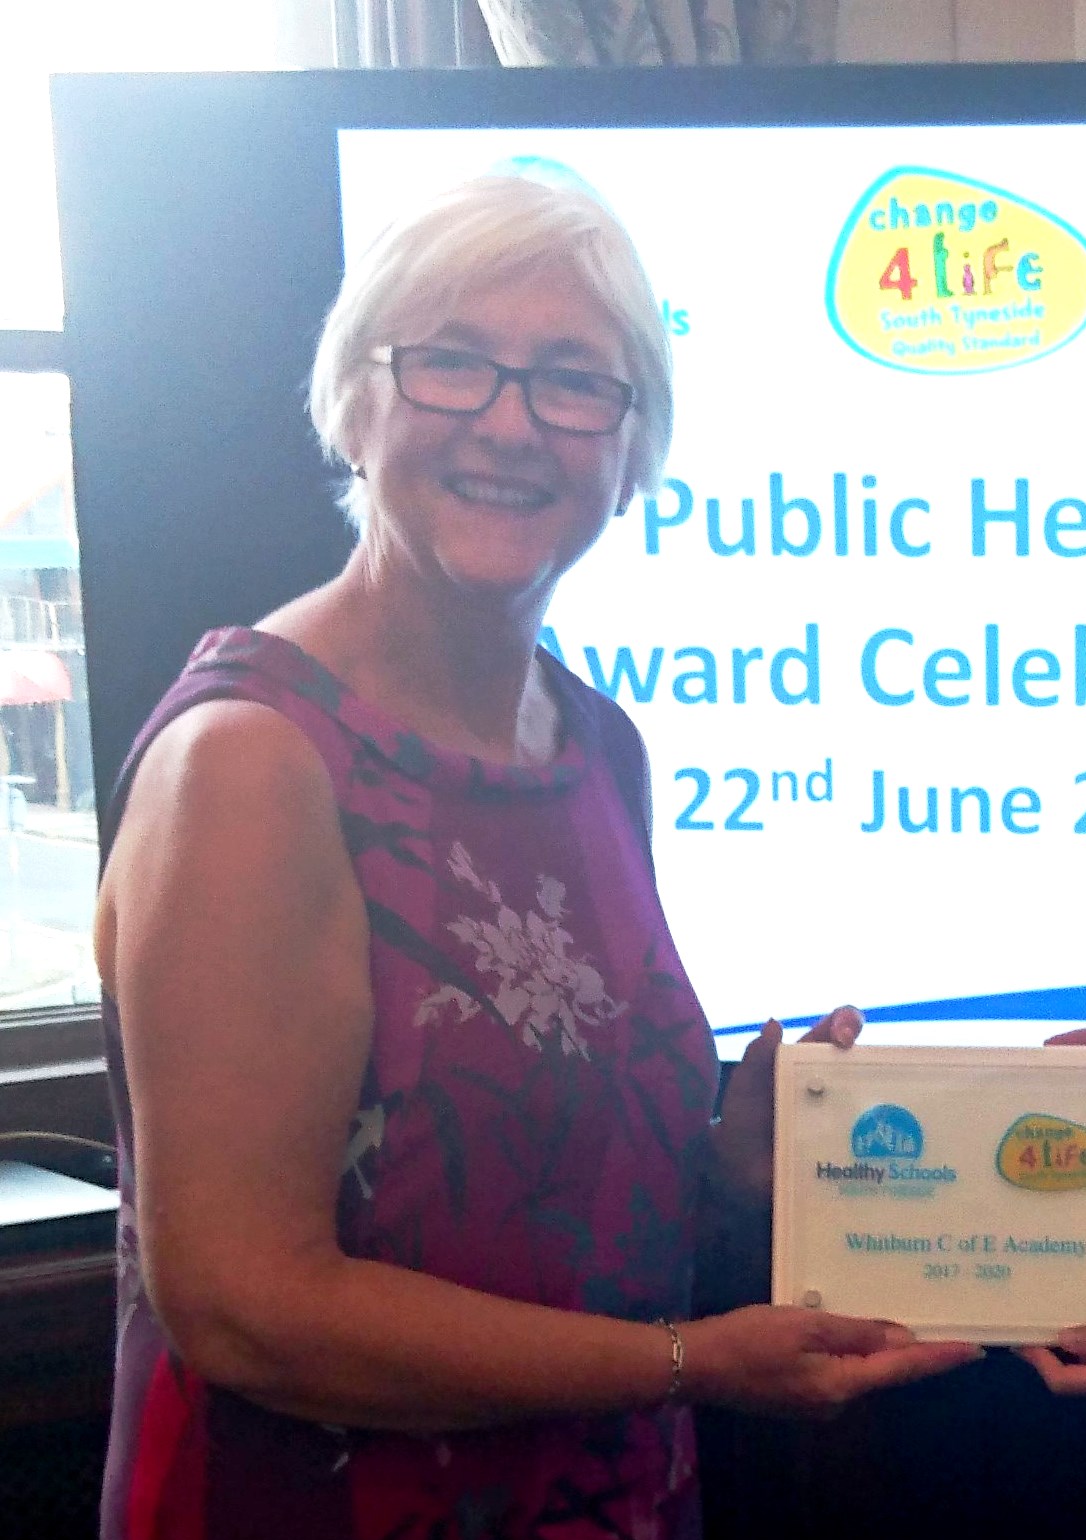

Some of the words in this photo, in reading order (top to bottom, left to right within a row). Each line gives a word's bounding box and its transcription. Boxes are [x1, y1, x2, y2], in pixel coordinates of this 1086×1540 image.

[868, 196, 998, 232] change
[880, 303, 942, 332] South
[950, 297, 1046, 330] Tyneside
[891, 336, 957, 359] Quality
[961, 328, 1042, 352] Standard
[644, 471, 932, 559] Public
[673, 756, 835, 832] 22nd
[859, 769, 1042, 835] June
[936, 1233, 952, 1252] C
[958, 1233, 979, 1252] of
